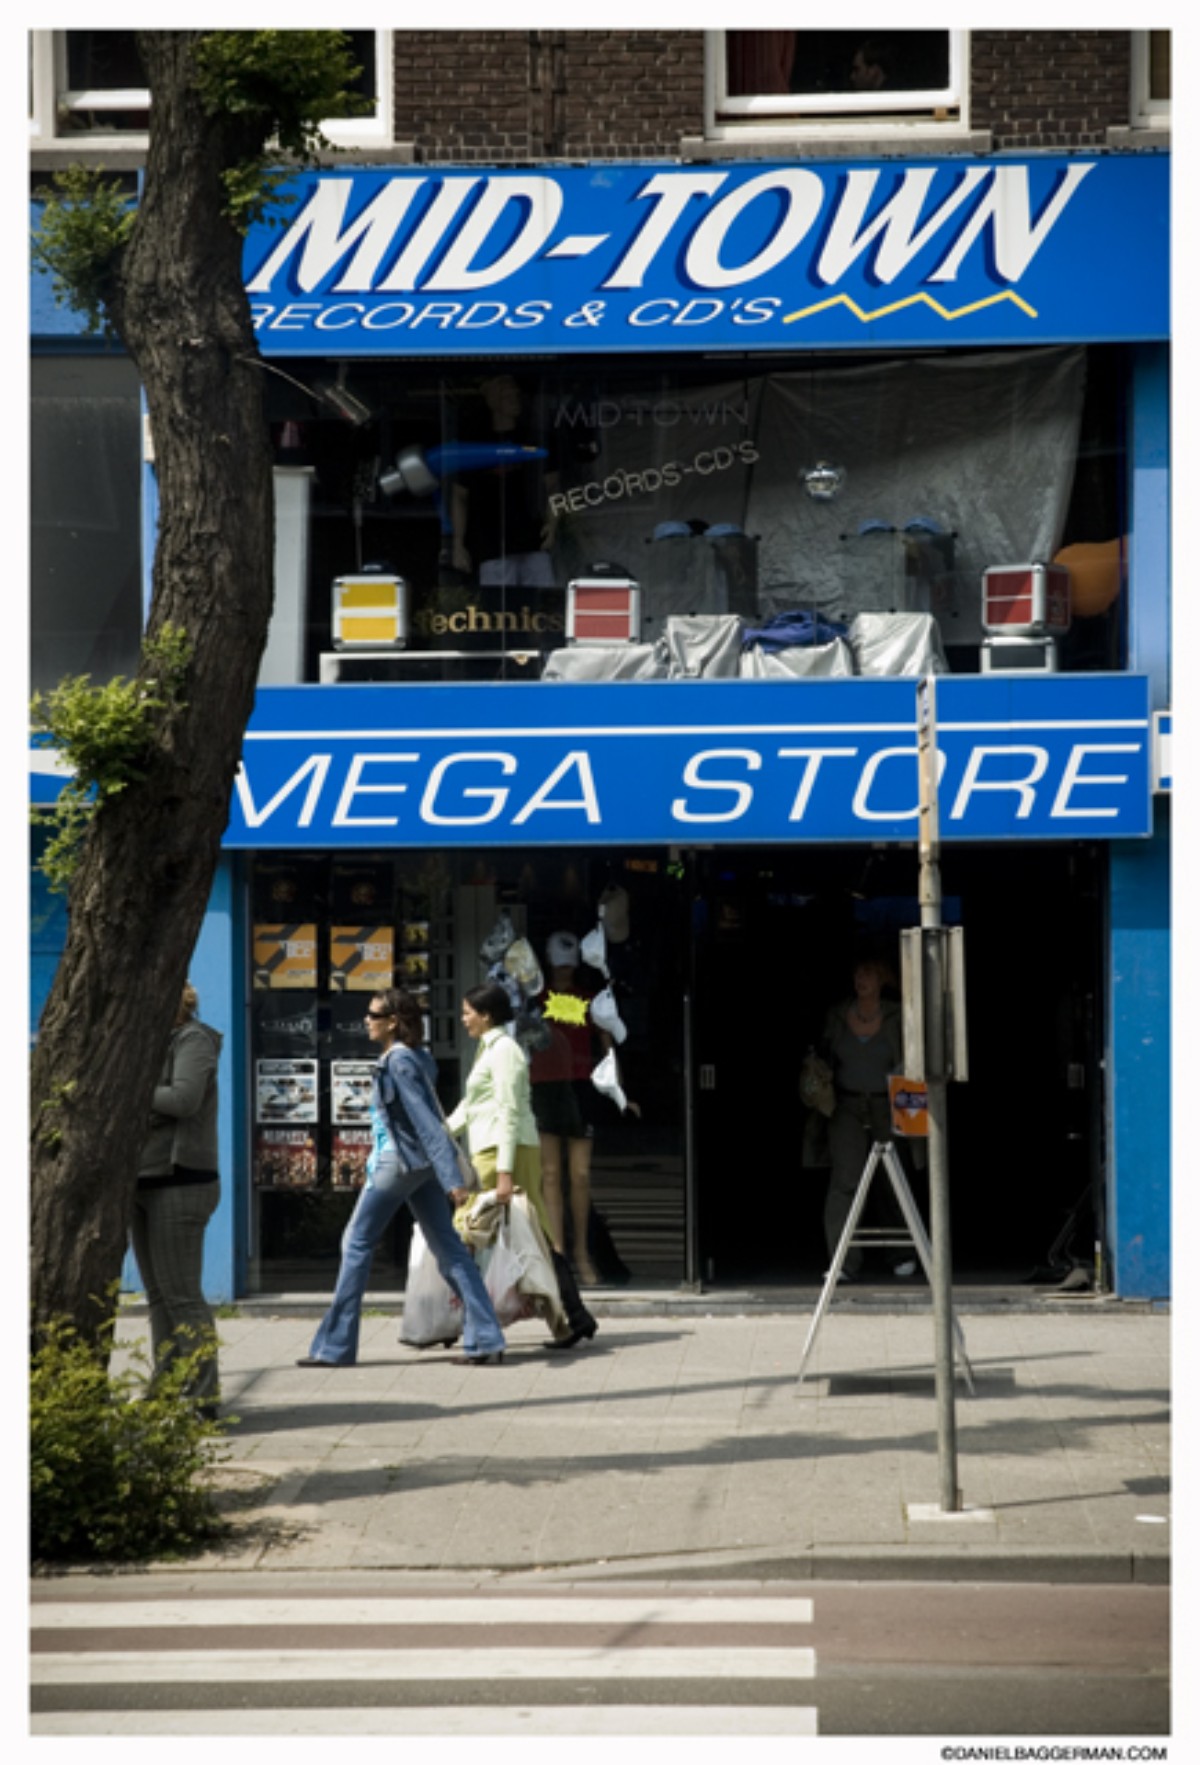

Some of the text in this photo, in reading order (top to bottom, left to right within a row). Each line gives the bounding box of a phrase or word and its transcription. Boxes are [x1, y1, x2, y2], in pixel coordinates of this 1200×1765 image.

[244, 163, 1098, 294] MID-TOWN
[250, 297, 782, 330] RECORDS & CD'S
[234, 744, 1142, 828] MEGA STORE
